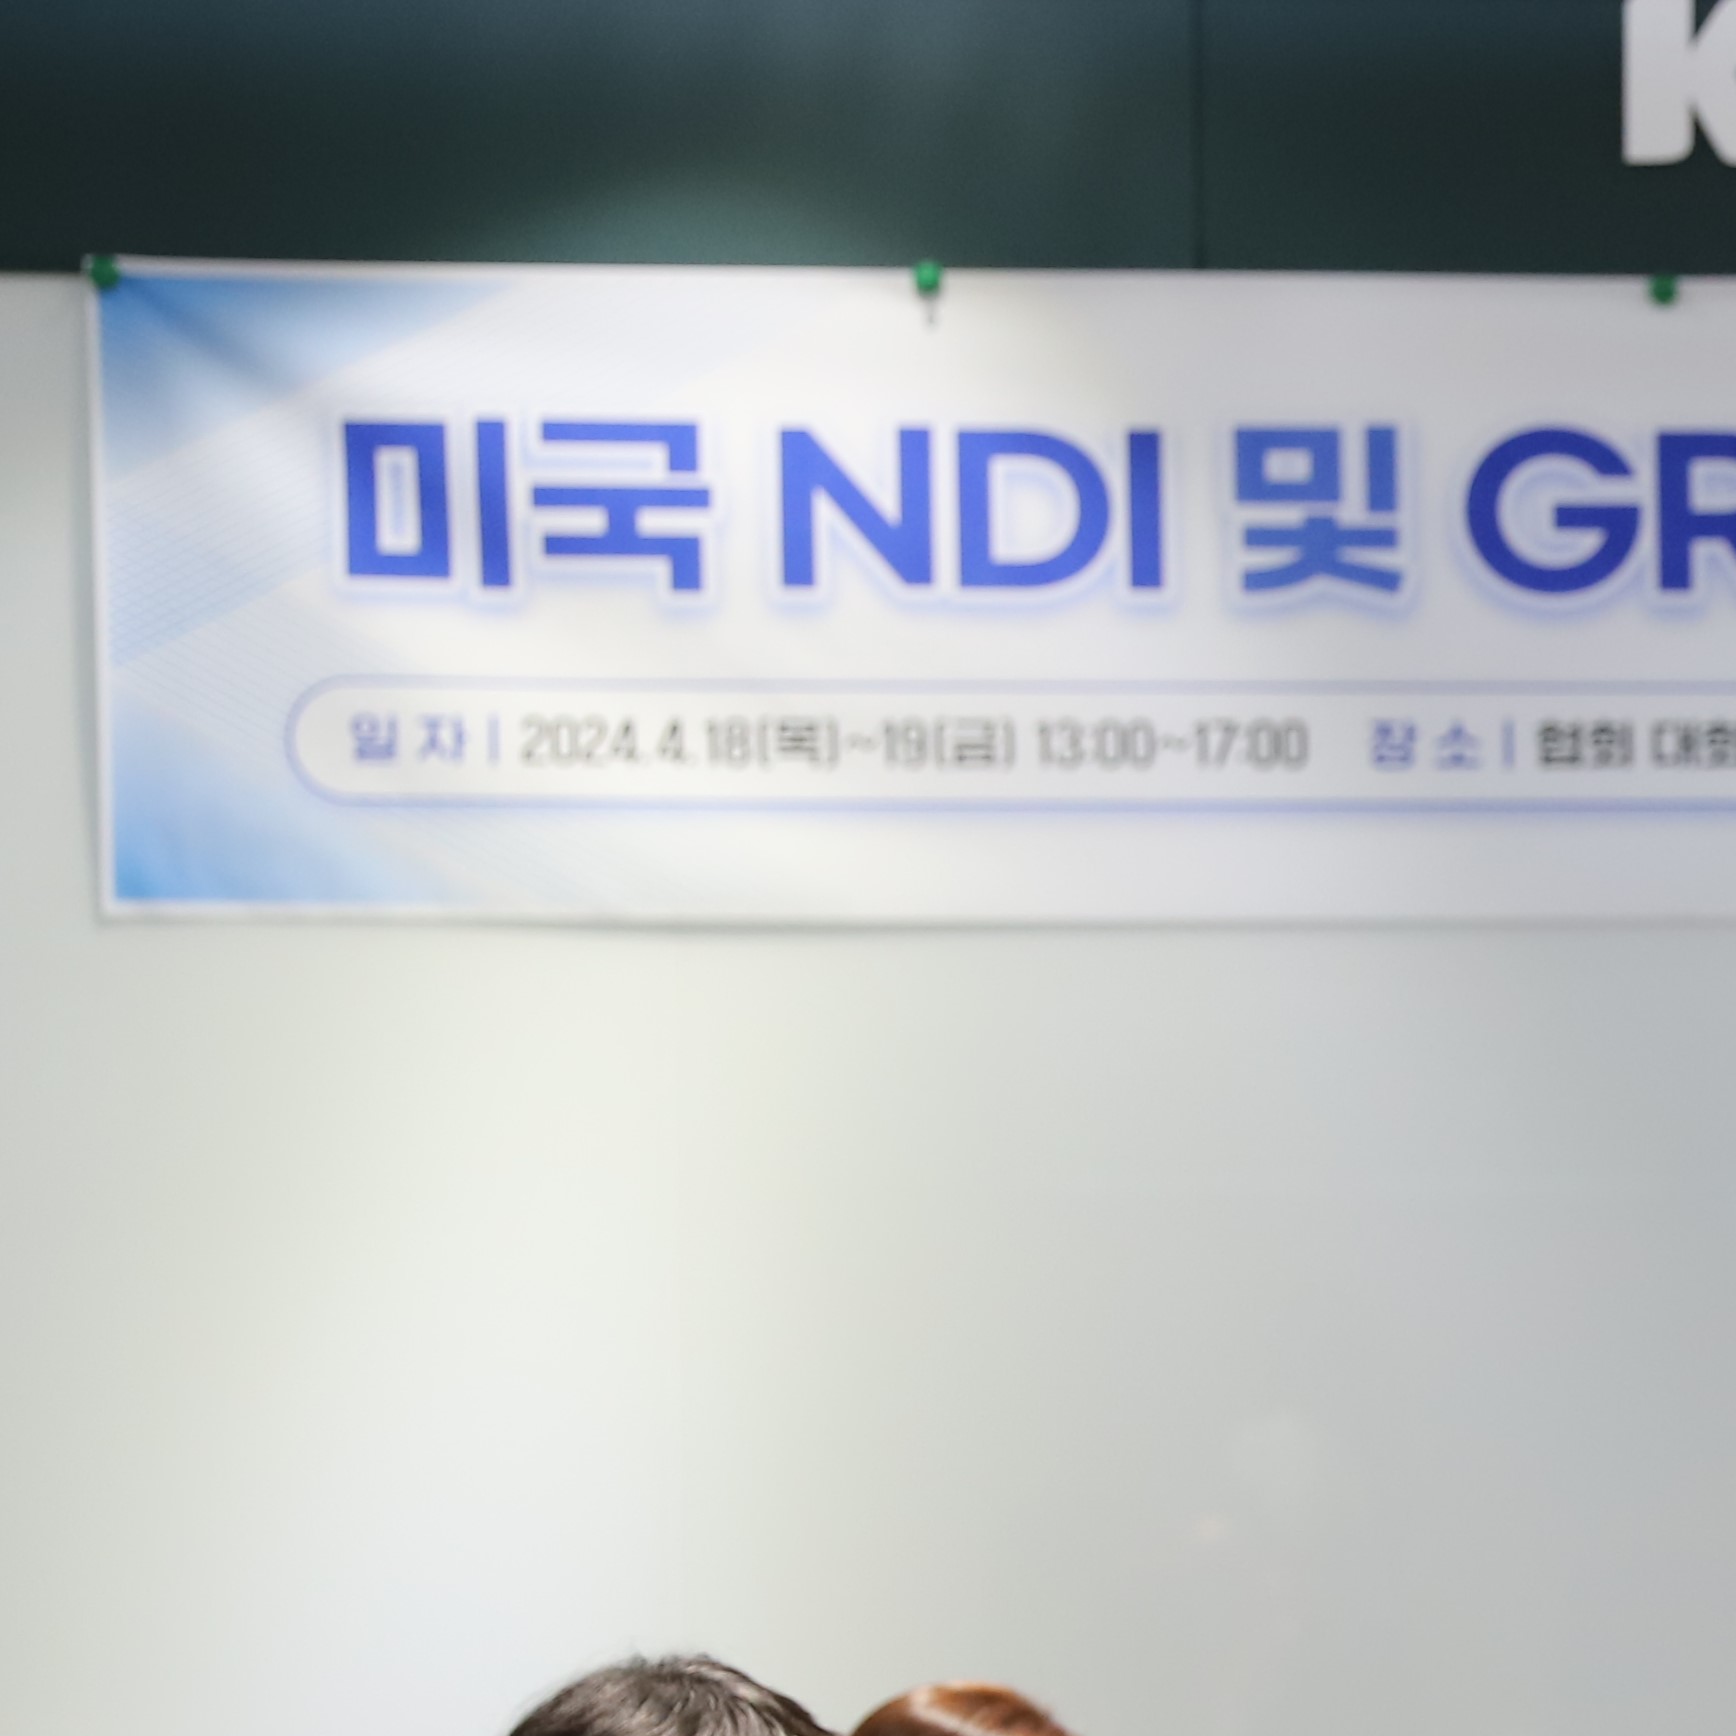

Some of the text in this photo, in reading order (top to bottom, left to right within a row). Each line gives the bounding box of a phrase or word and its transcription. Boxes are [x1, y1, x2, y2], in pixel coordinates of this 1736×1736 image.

[342, 418, 711, 591] 미국
[780, 427, 1163, 590] NDI
[1236, 427, 1402, 592] 및
[1035, 716, 1311, 771] 13:00~17:00
